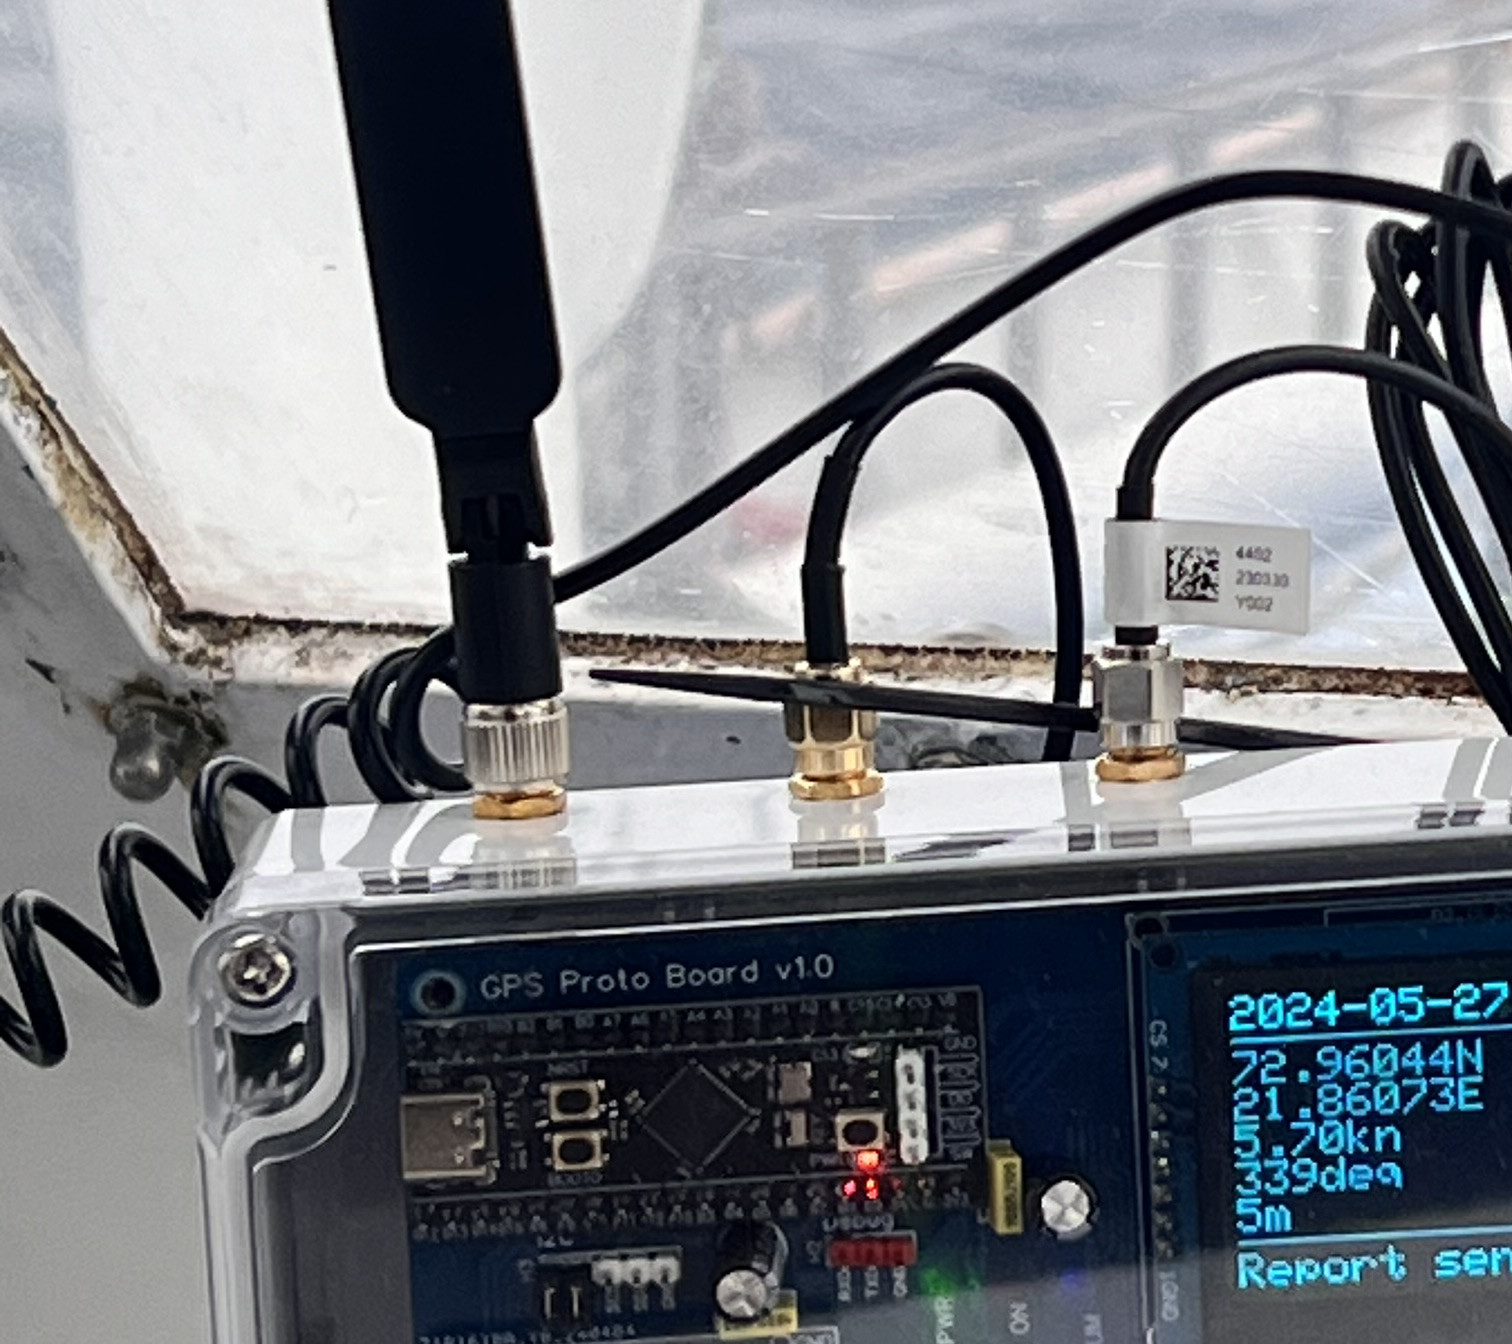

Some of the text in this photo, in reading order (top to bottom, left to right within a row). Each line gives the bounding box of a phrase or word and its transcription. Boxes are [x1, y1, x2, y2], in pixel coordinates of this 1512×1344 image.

[480, 953, 834, 1001] GPS Proto Board v1.0
[1228, 981, 1509, 1031] 2024-05-27
[1231, 1036, 1484, 1086] 72.96044N
[1233, 1074, 1484, 1123] 21.86073E
[1233, 1117, 1401, 1159] 5.70kn
[1235, 1197, 1293, 1234] 5m
[1237, 1244, 1407, 1289] Report
[1009, 1301, 1031, 1335] ON
